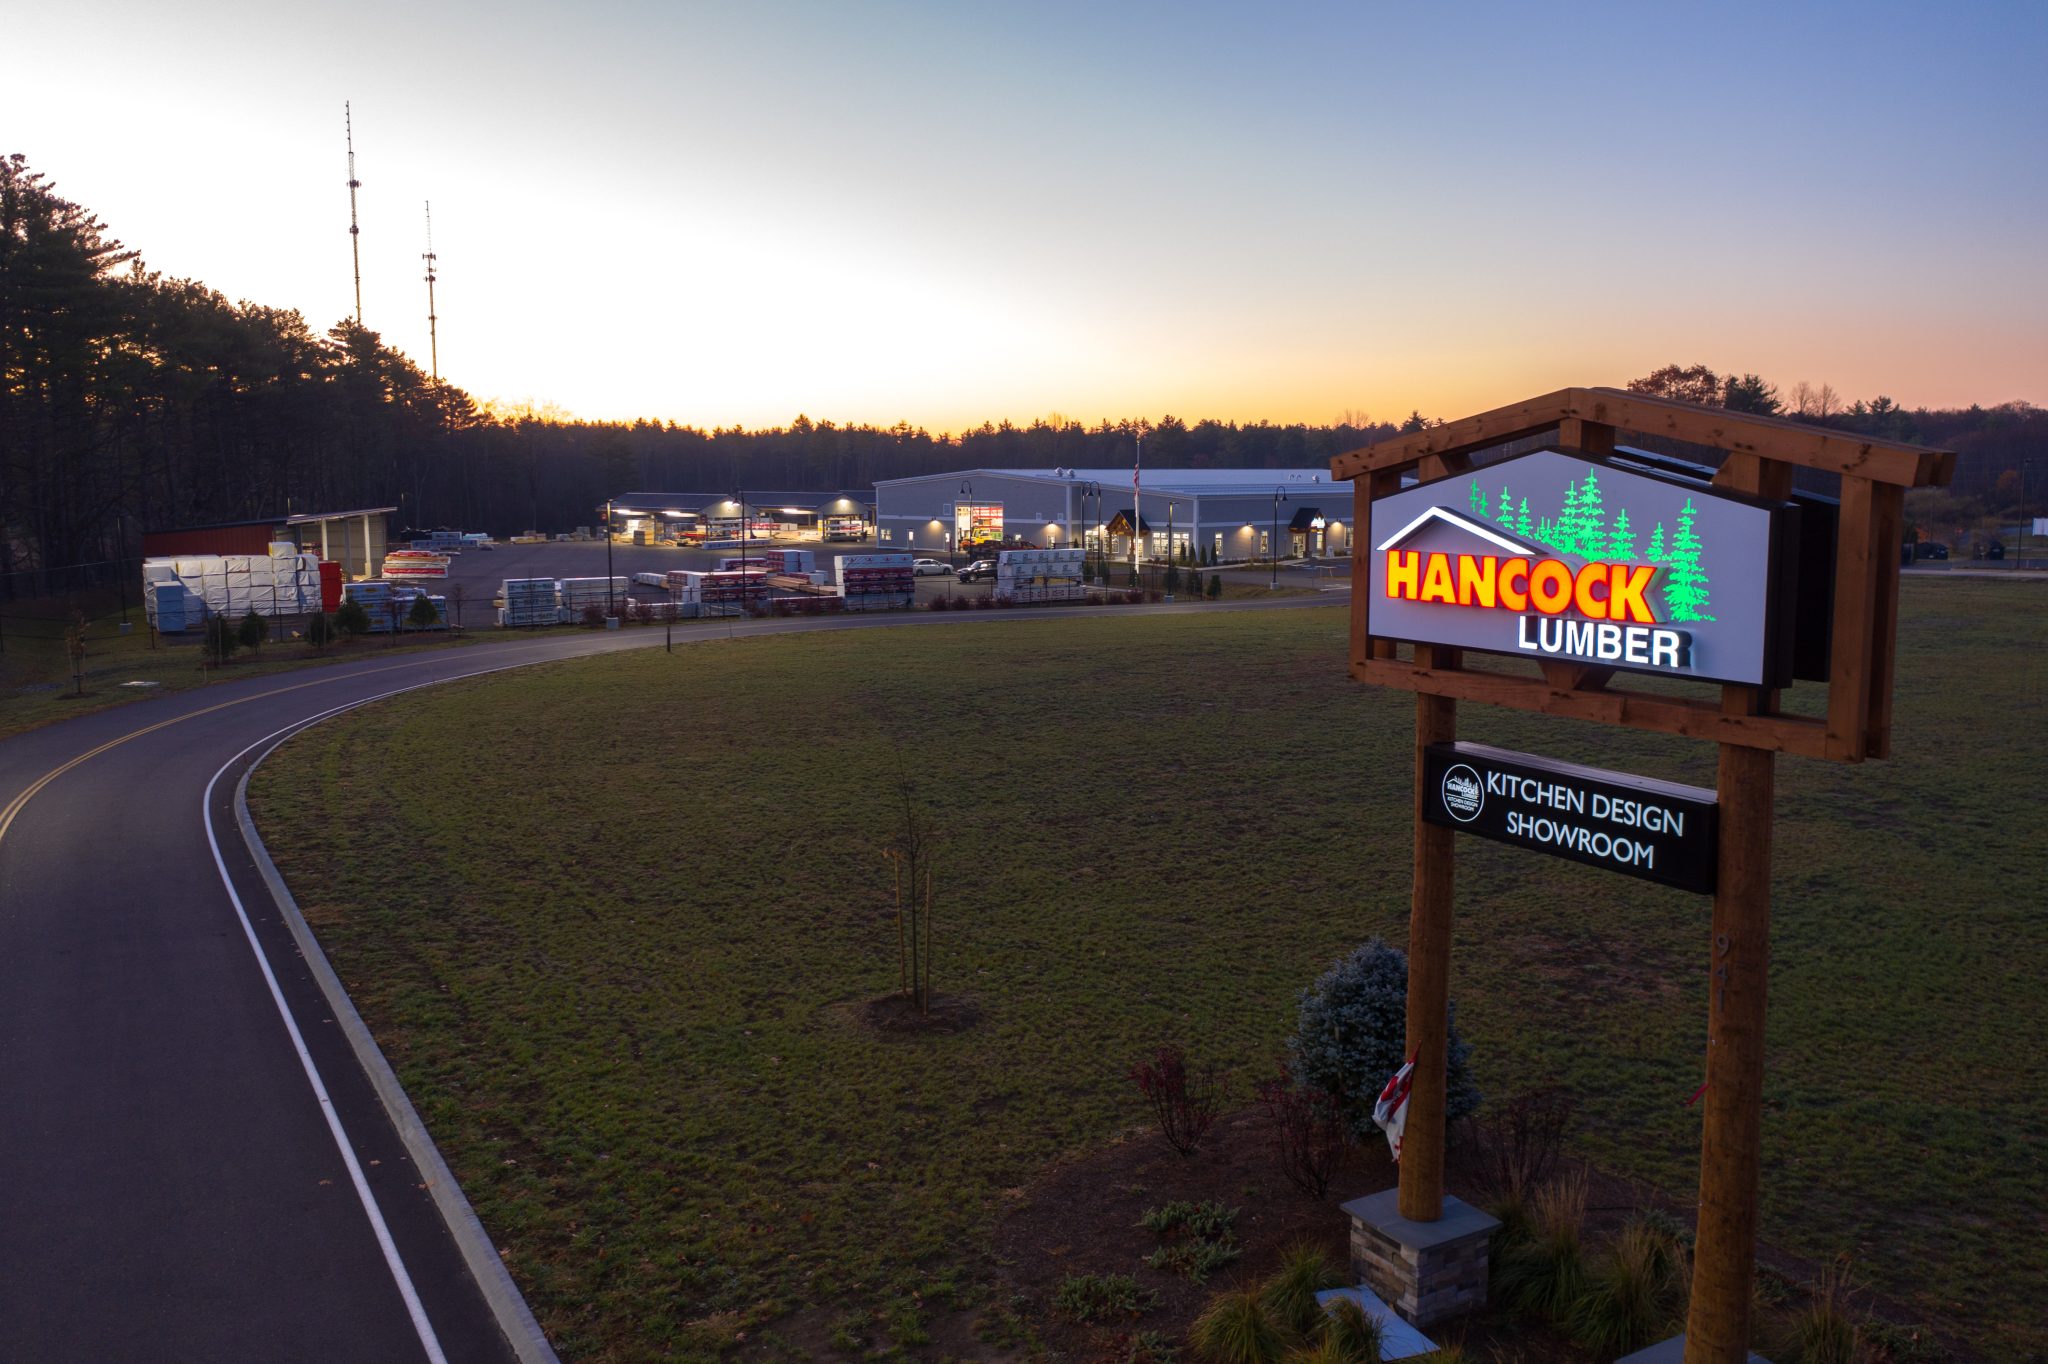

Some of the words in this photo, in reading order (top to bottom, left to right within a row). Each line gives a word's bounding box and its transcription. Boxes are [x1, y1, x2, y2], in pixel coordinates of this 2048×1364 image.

[1386, 550, 1658, 624] HANCOCK
[1518, 615, 1680, 668] LUMBER
[1487, 770, 1585, 814] KITCHEN
[1592, 793, 1684, 837] DESIGN
[1507, 811, 1654, 869] SHOWROOM
